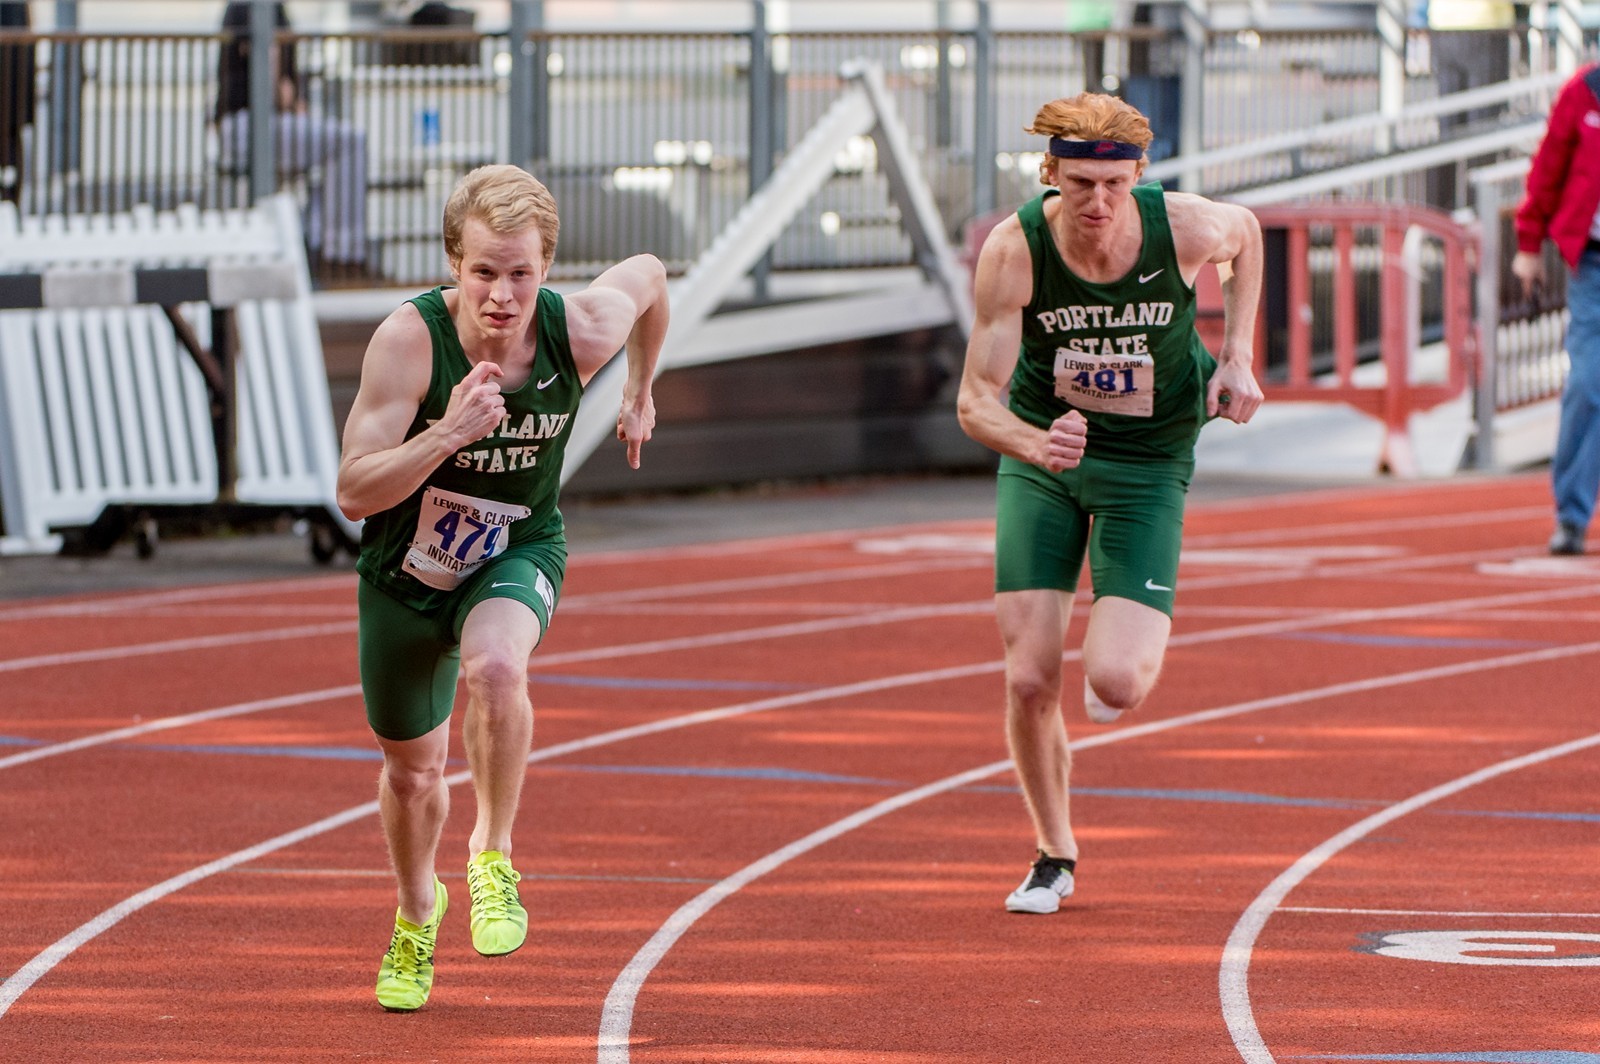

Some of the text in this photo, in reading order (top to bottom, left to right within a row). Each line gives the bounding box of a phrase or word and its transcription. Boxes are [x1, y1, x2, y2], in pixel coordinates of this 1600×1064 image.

[1037, 302, 1174, 333] PORTLAND
[1069, 333, 1148, 355] STATE
[1064, 359, 1095, 371] LEWIS
[1110, 360, 1143, 369] CLARK
[1071, 368, 1138, 394] 481
[1071, 384, 1137, 399] INVITATION
[426, 412, 570, 440] LAND
[454, 445, 540, 473] STATE
[433, 496, 469, 514] LEWIS
[471, 508, 481, 521] &
[433, 510, 503, 562] 479
